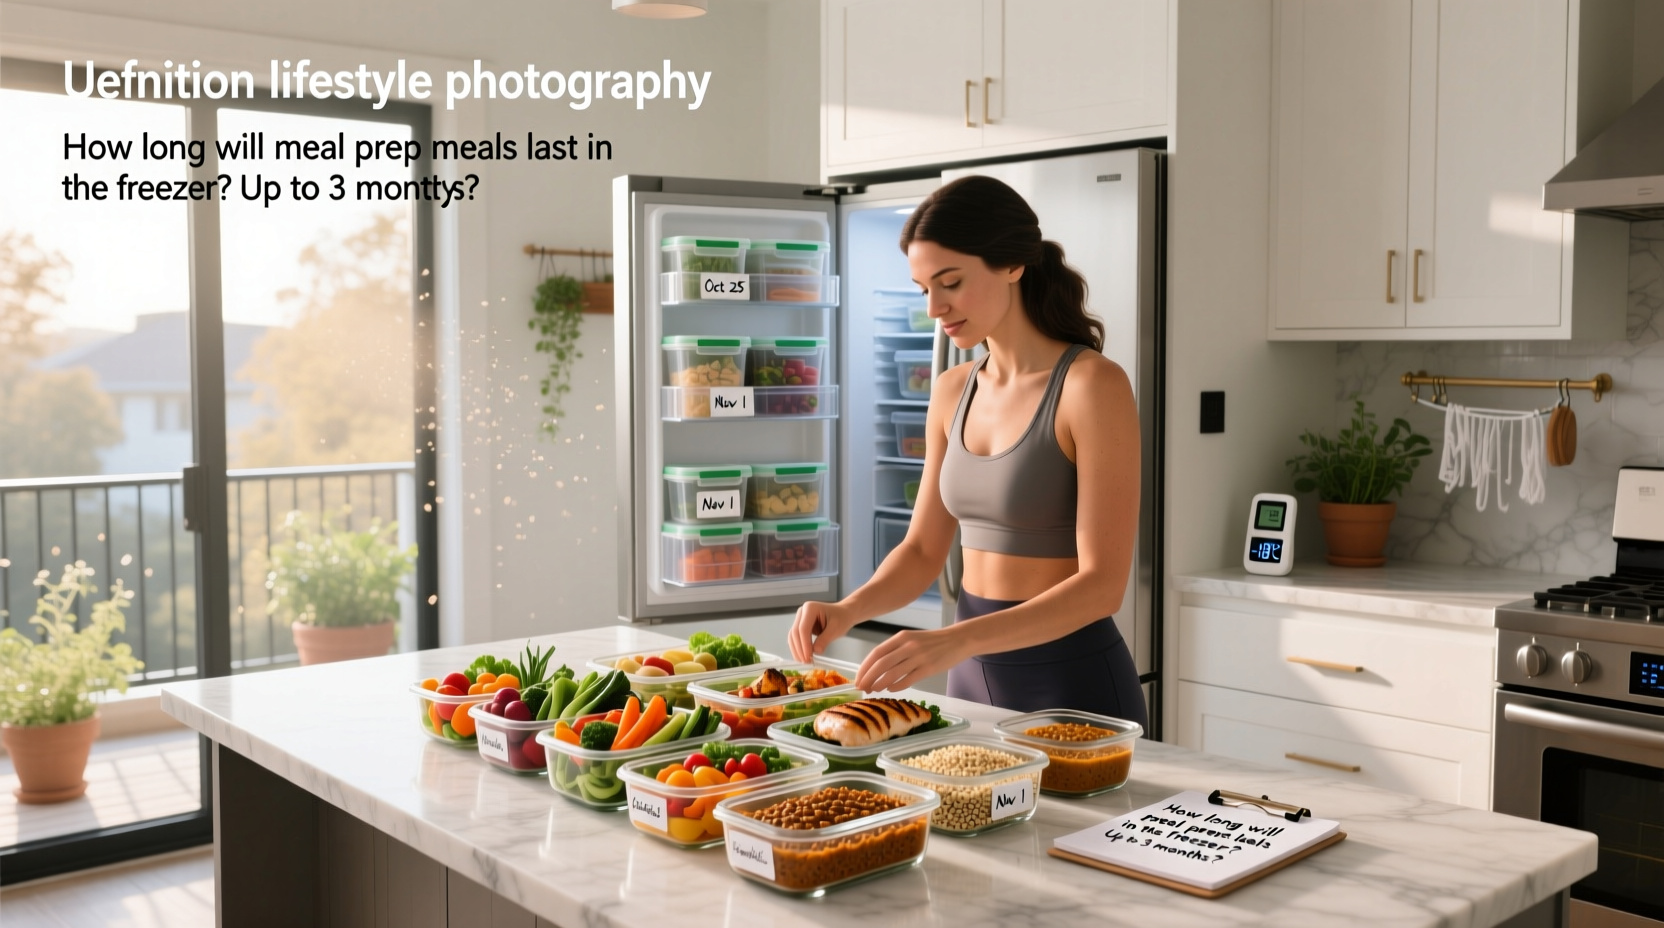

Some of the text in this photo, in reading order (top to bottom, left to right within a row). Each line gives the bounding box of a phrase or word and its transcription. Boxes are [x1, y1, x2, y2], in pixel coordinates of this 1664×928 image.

[705, 278, 746, 293] Oct 25
[702, 496, 725, 511] Nov
[1121, 819, 1137, 830] in
[1162, 803, 1285, 837] How long will
[1104, 828, 1124, 842] Up
